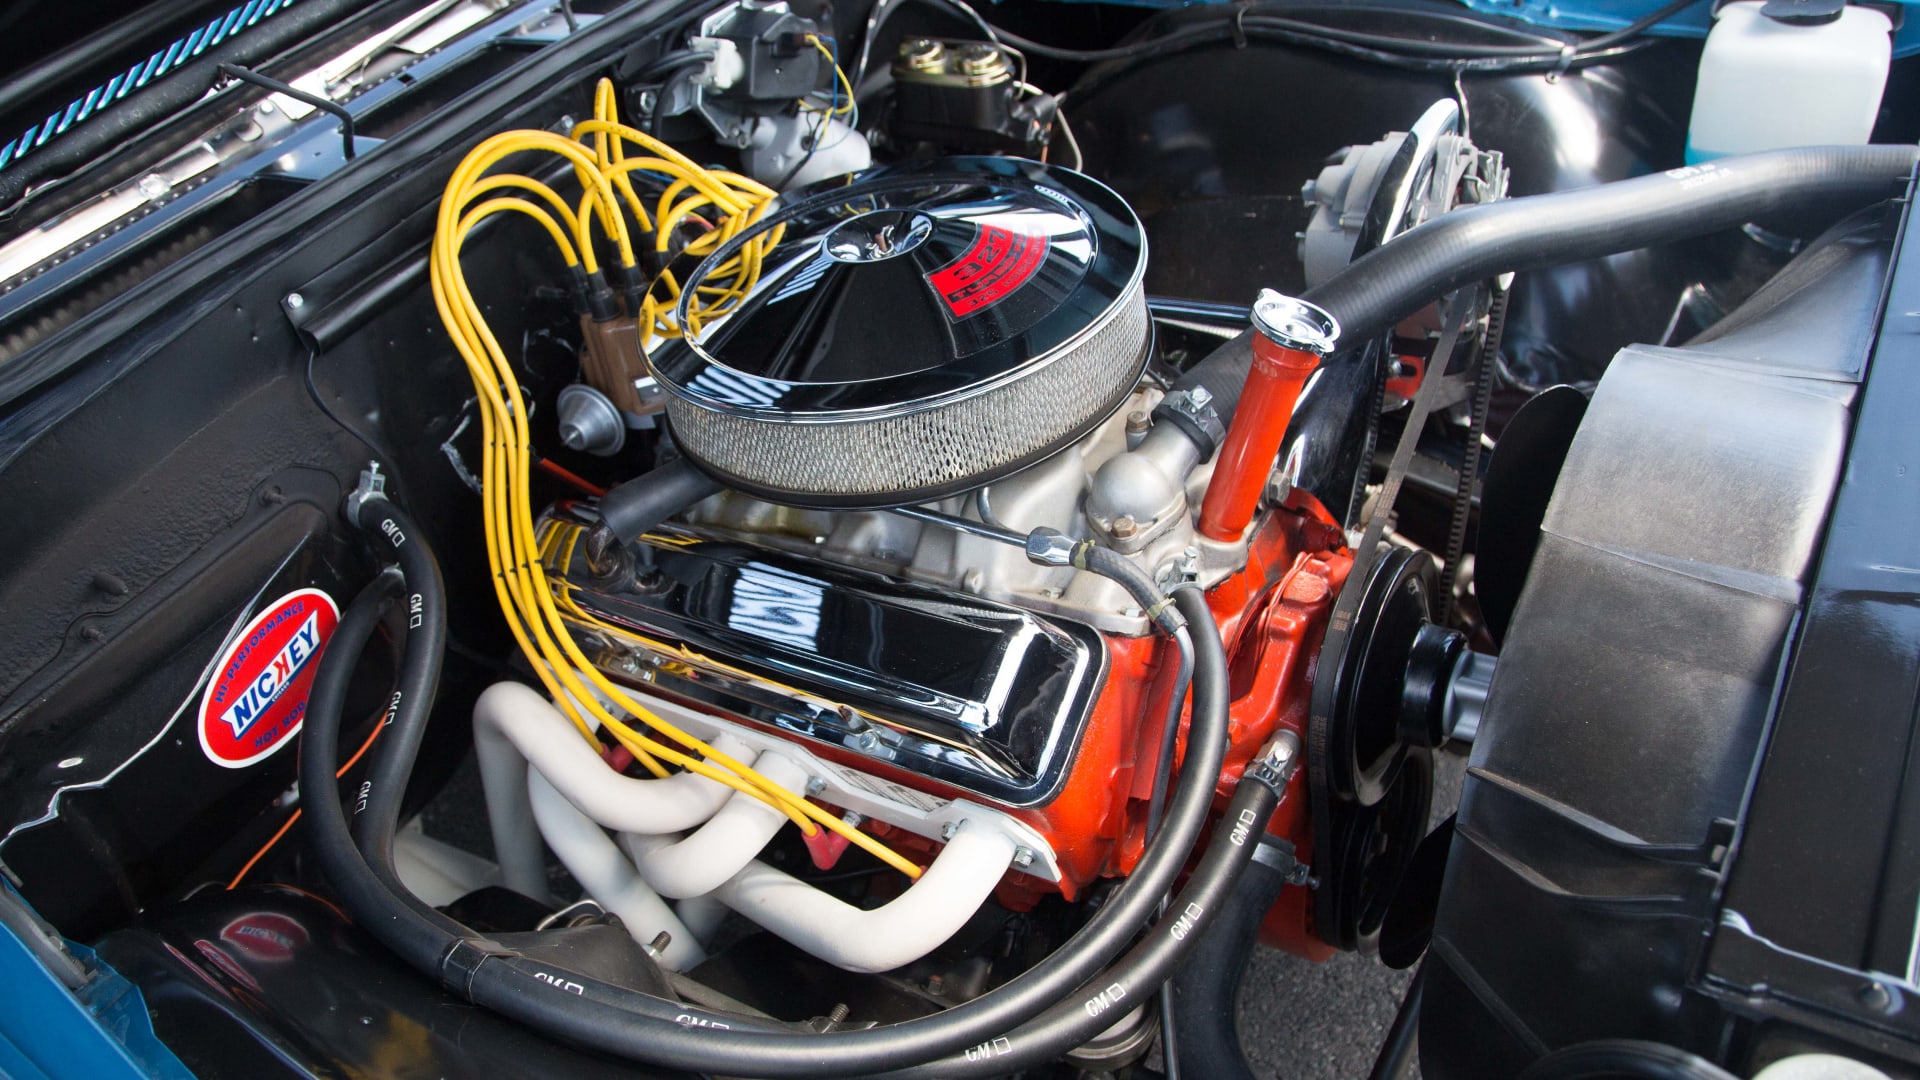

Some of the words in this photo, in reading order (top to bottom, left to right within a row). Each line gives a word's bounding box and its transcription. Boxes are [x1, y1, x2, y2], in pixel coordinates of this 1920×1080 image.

[953, 229, 1006, 281] 327
[382, 518, 399, 536] GM
[410, 593, 423, 613] GM
[215, 601, 305, 703] HI-PERFORMANCE
[233, 620, 315, 729] NICKEY
[389, 690, 402, 710] GM
[254, 725, 279, 749] HOT
[358, 781, 371, 800] GM
[1230, 821, 1250, 846] GM
[1170, 915, 1193, 941] GM
[1084, 992, 1110, 1016] GM
[965, 1043, 991, 1061] GM
